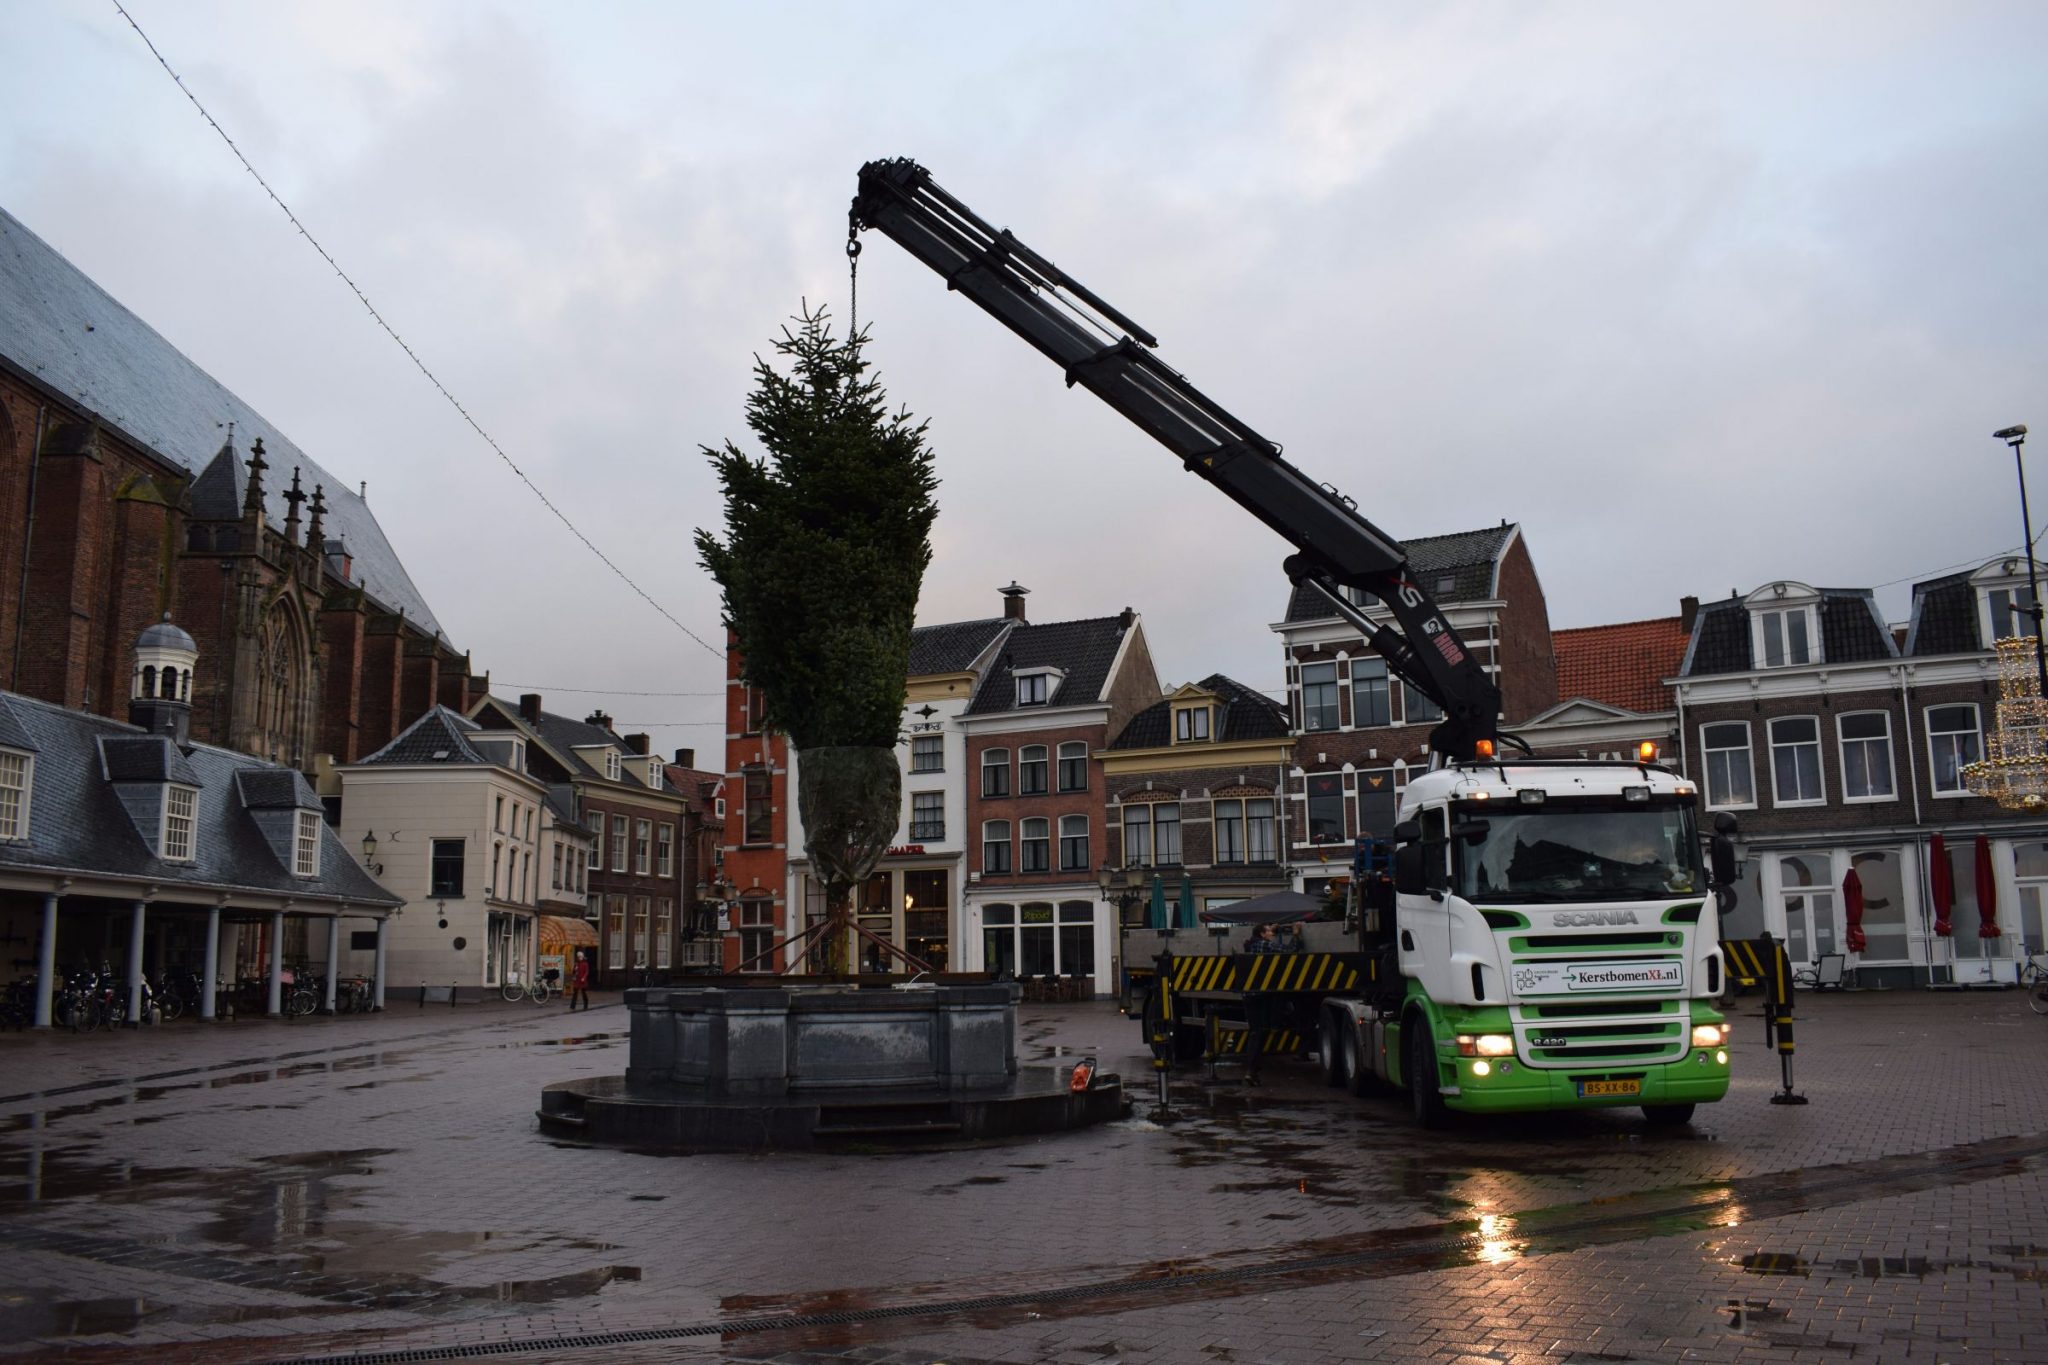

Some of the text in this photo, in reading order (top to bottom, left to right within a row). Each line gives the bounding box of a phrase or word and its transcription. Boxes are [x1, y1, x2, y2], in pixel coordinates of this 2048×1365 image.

[1433, 632, 1464, 667] HIAB
[1553, 910, 1639, 928] SCANIA
[1579, 968, 1678, 983] KerstbomenXL.nl
[1586, 1081, 1637, 1094] BS-XX-86
